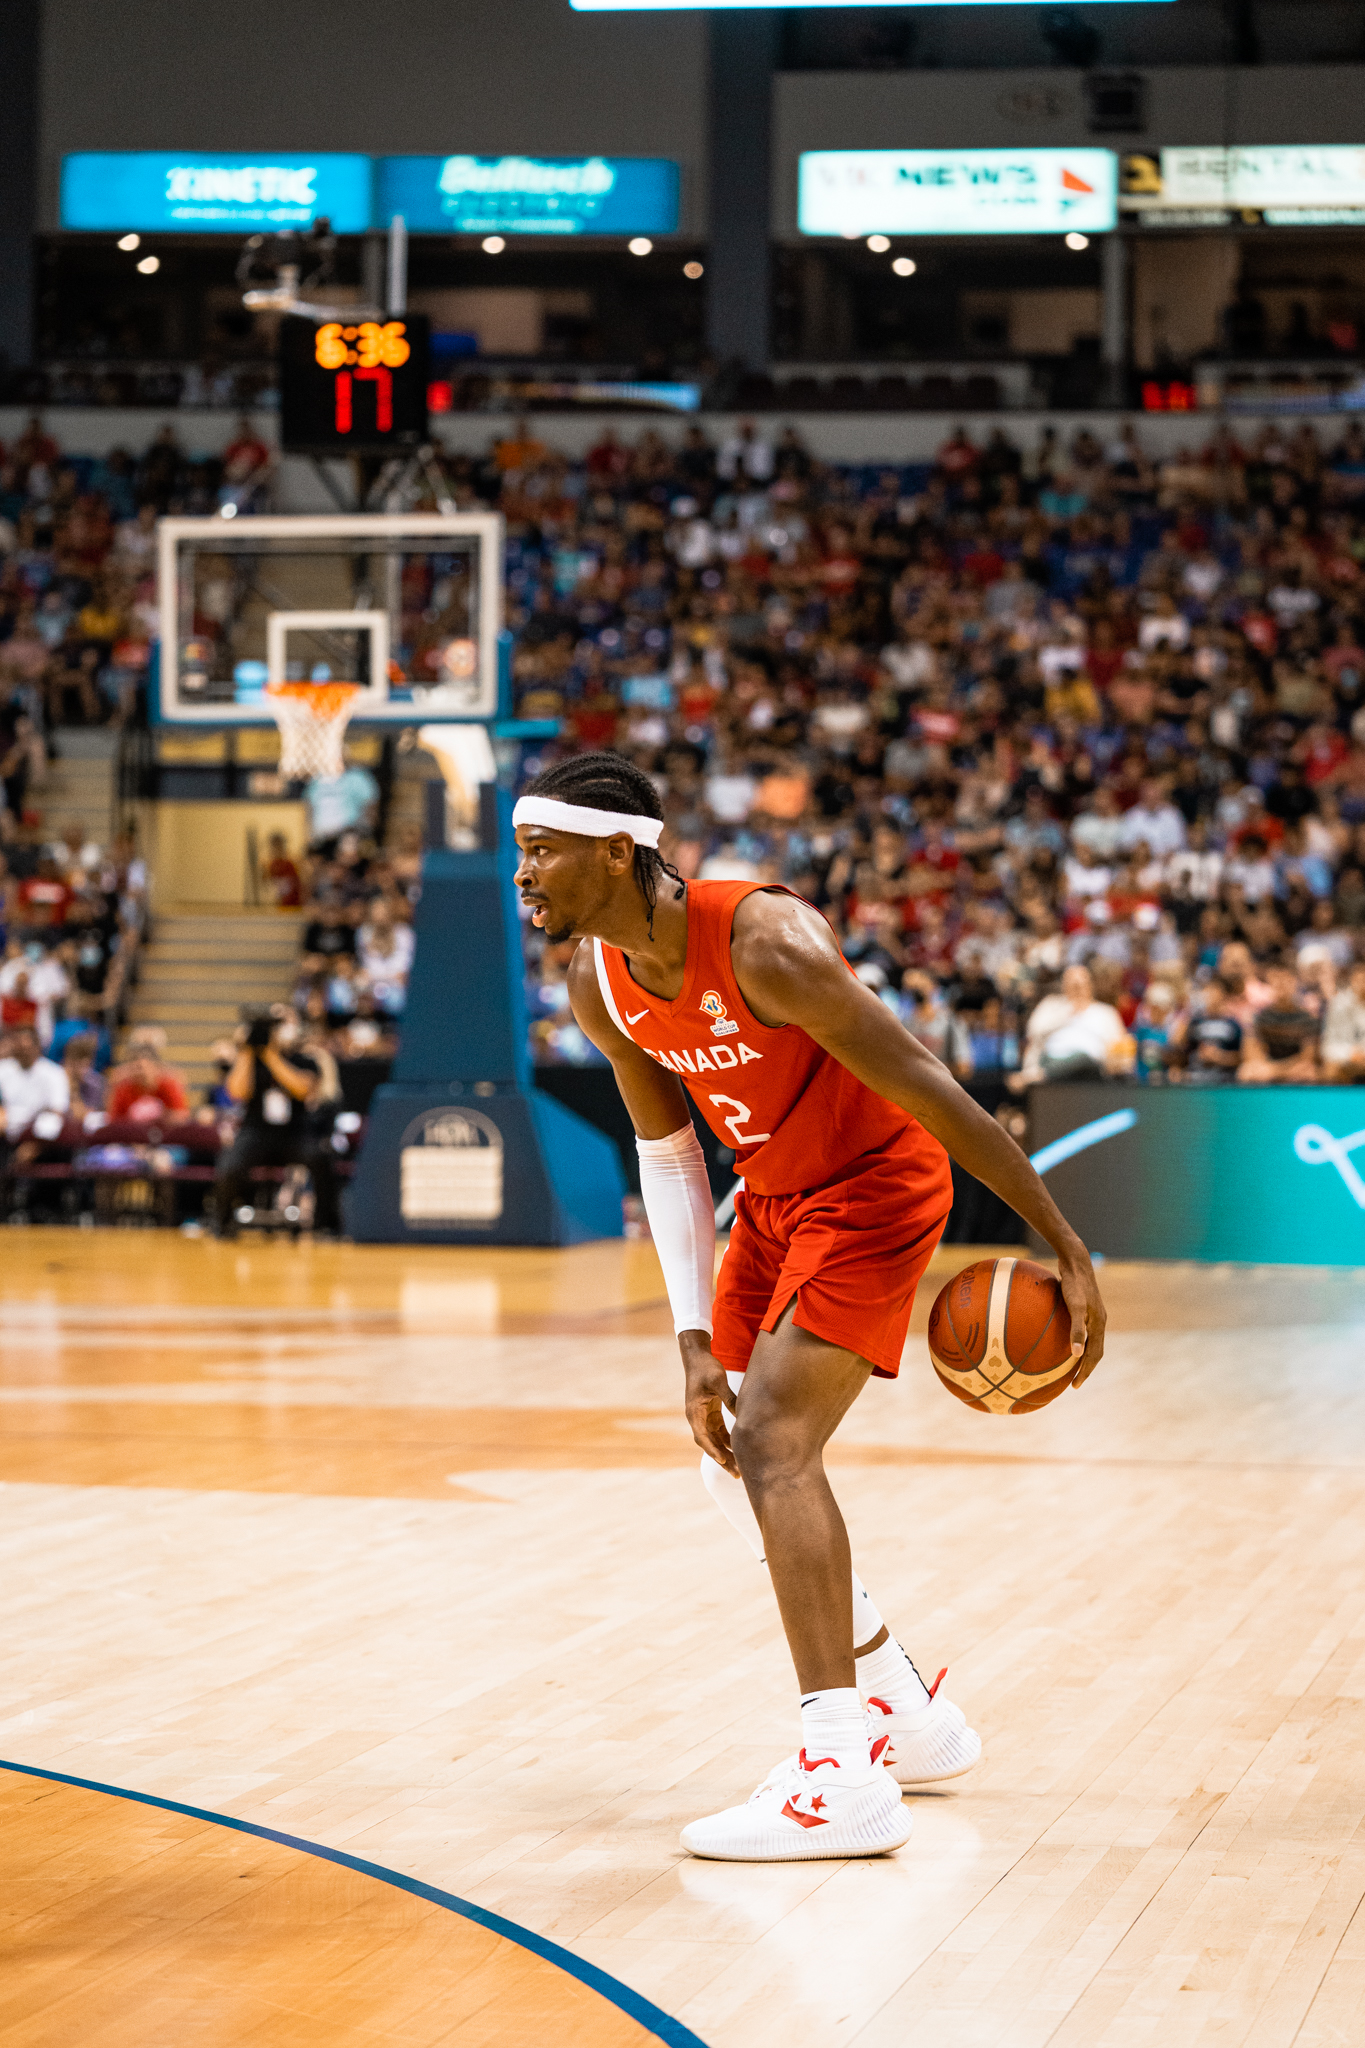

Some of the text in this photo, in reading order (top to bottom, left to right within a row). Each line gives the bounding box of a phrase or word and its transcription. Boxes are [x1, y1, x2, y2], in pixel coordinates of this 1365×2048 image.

[315, 322, 411, 369] 6:36
[335, 366, 394, 434] 17
[708, 1094, 772, 1145] 2
